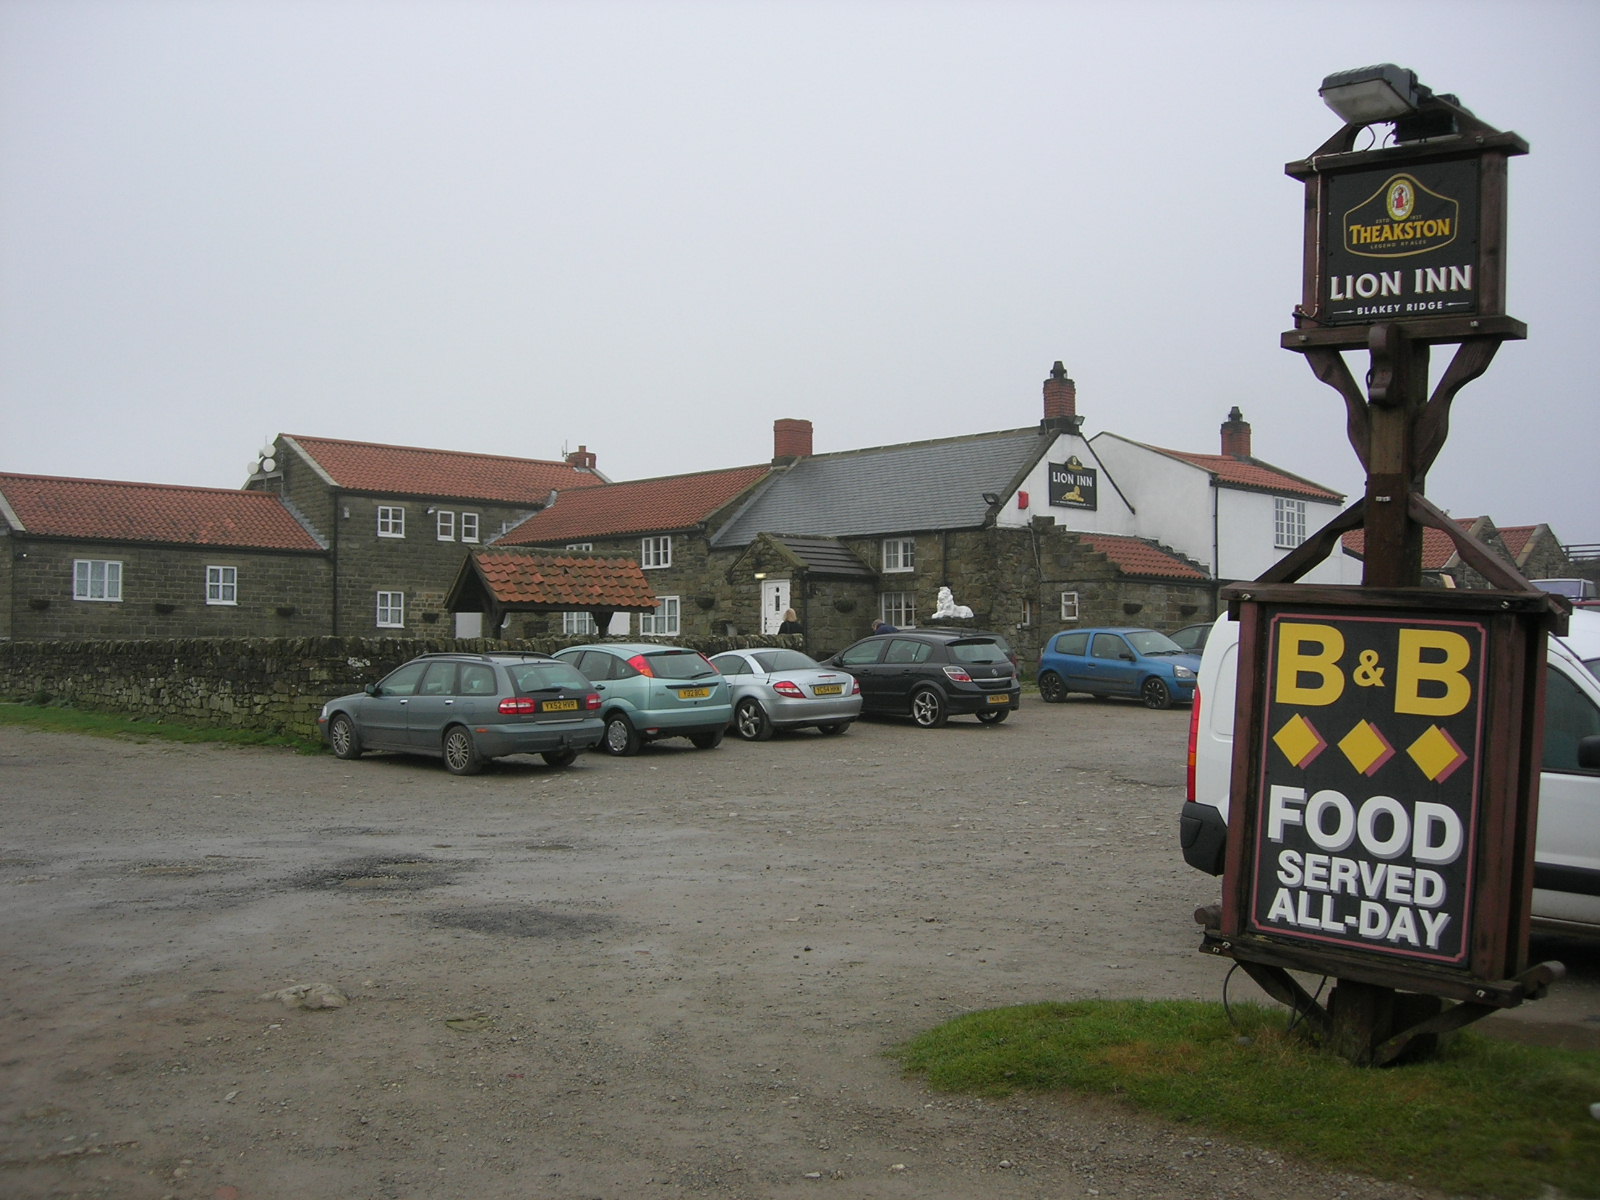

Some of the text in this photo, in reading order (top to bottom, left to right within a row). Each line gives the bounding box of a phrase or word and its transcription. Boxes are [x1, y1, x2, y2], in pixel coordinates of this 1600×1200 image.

[1349, 218, 1451, 245] THEAKSTON
[1330, 264, 1472, 301] LION INN
[1357, 301, 1443, 315] BLAKEY RIDGE
[1052, 472, 1093, 487] LION INN
[1267, 784, 1464, 865] FOOD
[1276, 849, 1446, 909] SERVED
[1266, 887, 1451, 949] ALL-DAY
